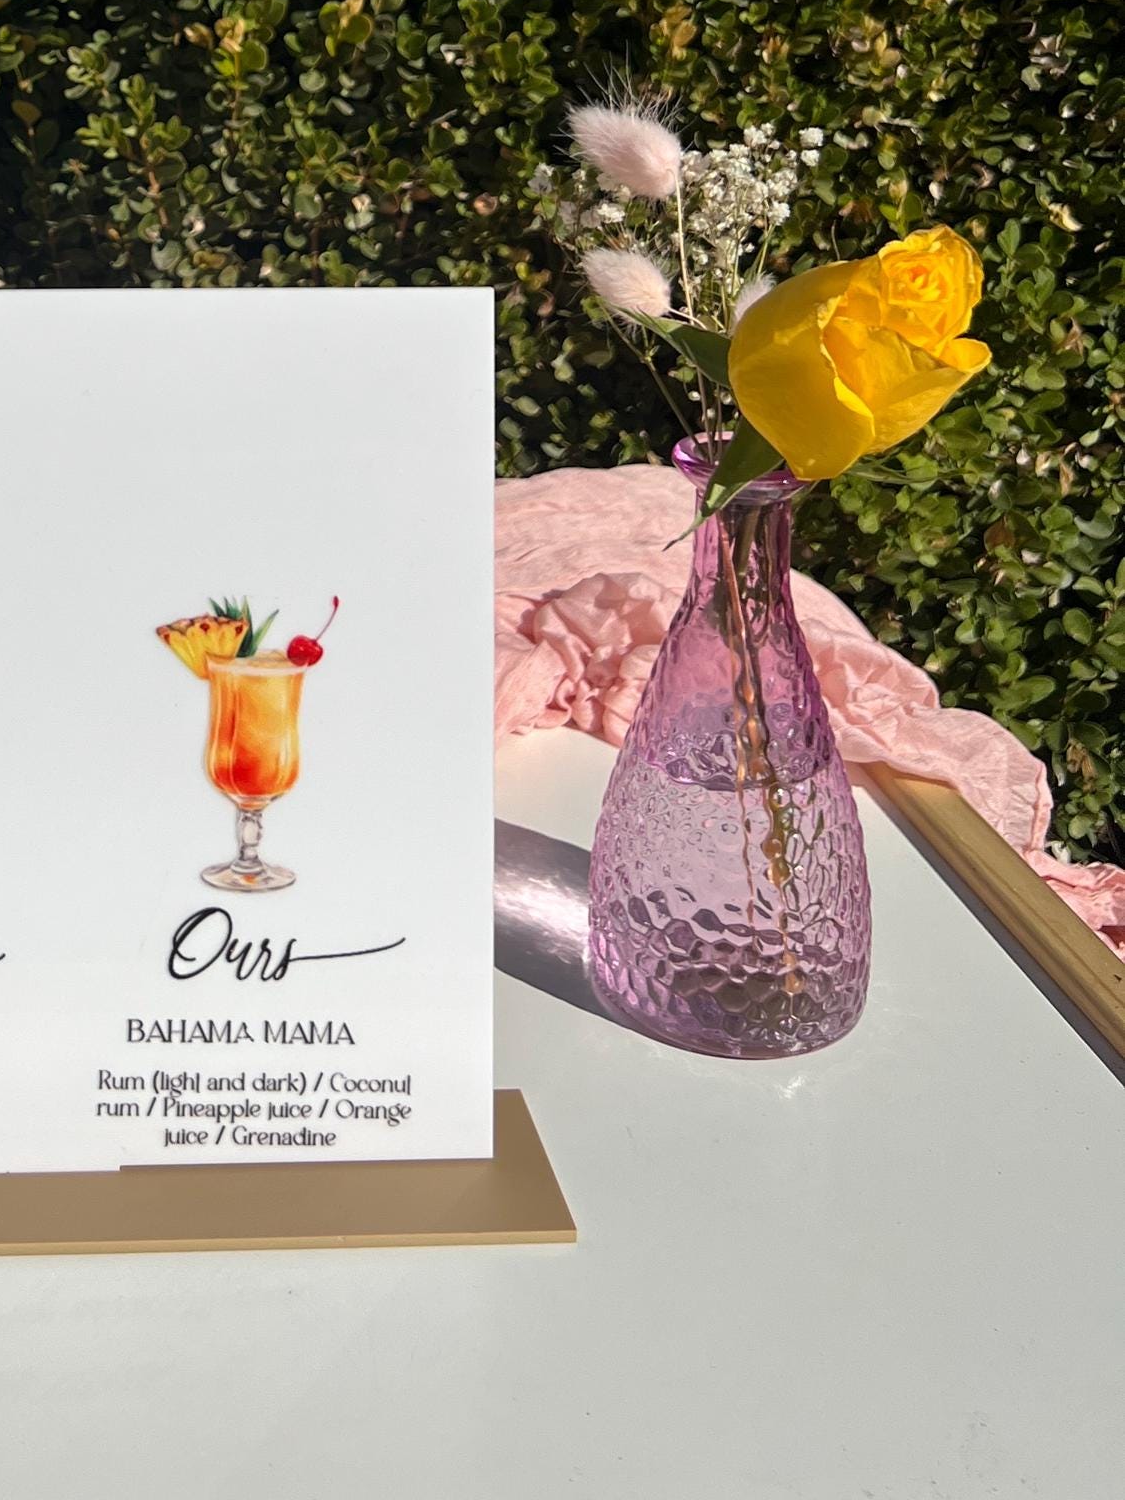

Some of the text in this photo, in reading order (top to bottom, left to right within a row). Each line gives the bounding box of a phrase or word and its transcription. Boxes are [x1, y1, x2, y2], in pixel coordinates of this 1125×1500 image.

[168, 907, 406, 981] Ours
[127, 1019, 355, 1044] BAHAMA MAMA
[98, 1070, 144, 1090] Rum
[153, 1070, 200, 1097] (light
[207, 1072, 245, 1091] and
[253, 1072, 307, 1093] dark)
[330, 1073, 411, 1095] Coconut
[97, 1101, 139, 1116] rum
[163, 1098, 261, 1123] Pineapple
[268, 1100, 312, 1121] juice
[336, 1100, 412, 1126] Orange
[164, 1128, 208, 1147] juice
[233, 1126, 336, 1146] Grenadine
